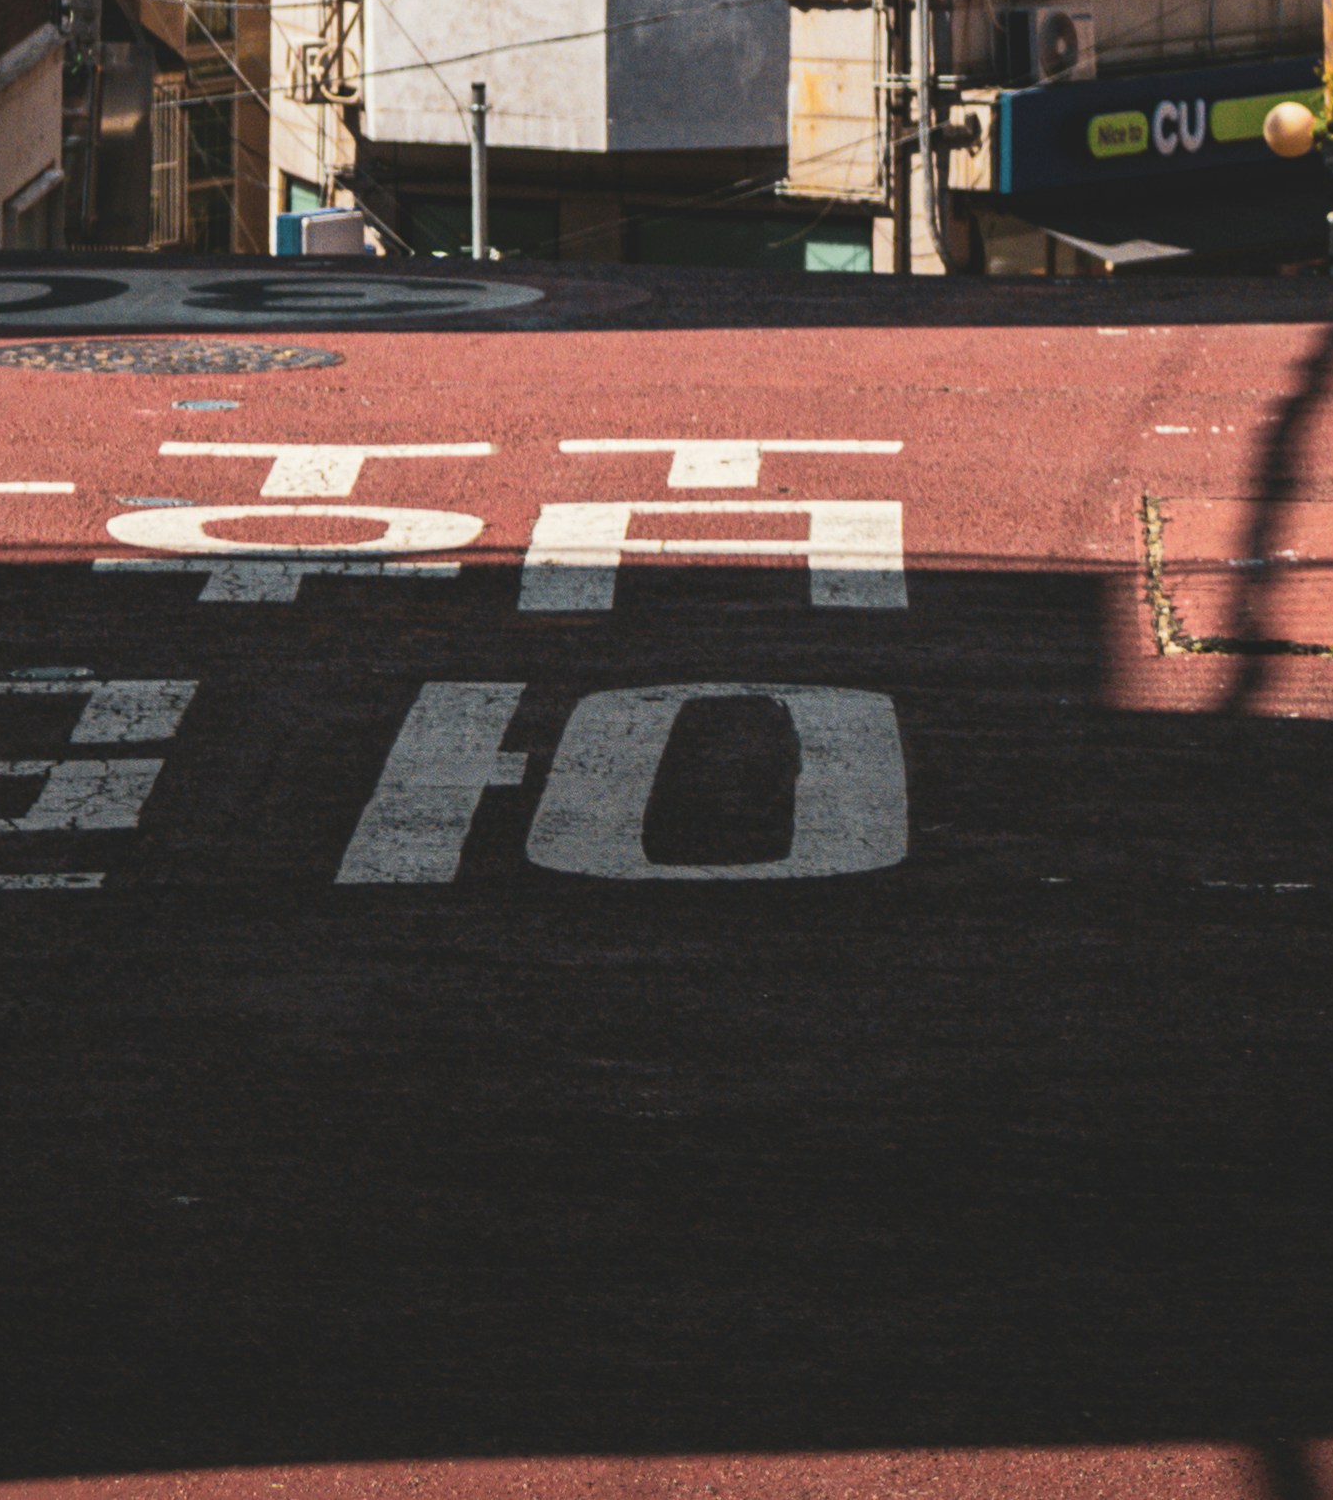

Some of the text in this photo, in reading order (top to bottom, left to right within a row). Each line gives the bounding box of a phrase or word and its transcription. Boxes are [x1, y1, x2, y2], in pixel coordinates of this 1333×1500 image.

[1098, 97, 1207, 156] Nice to CU
